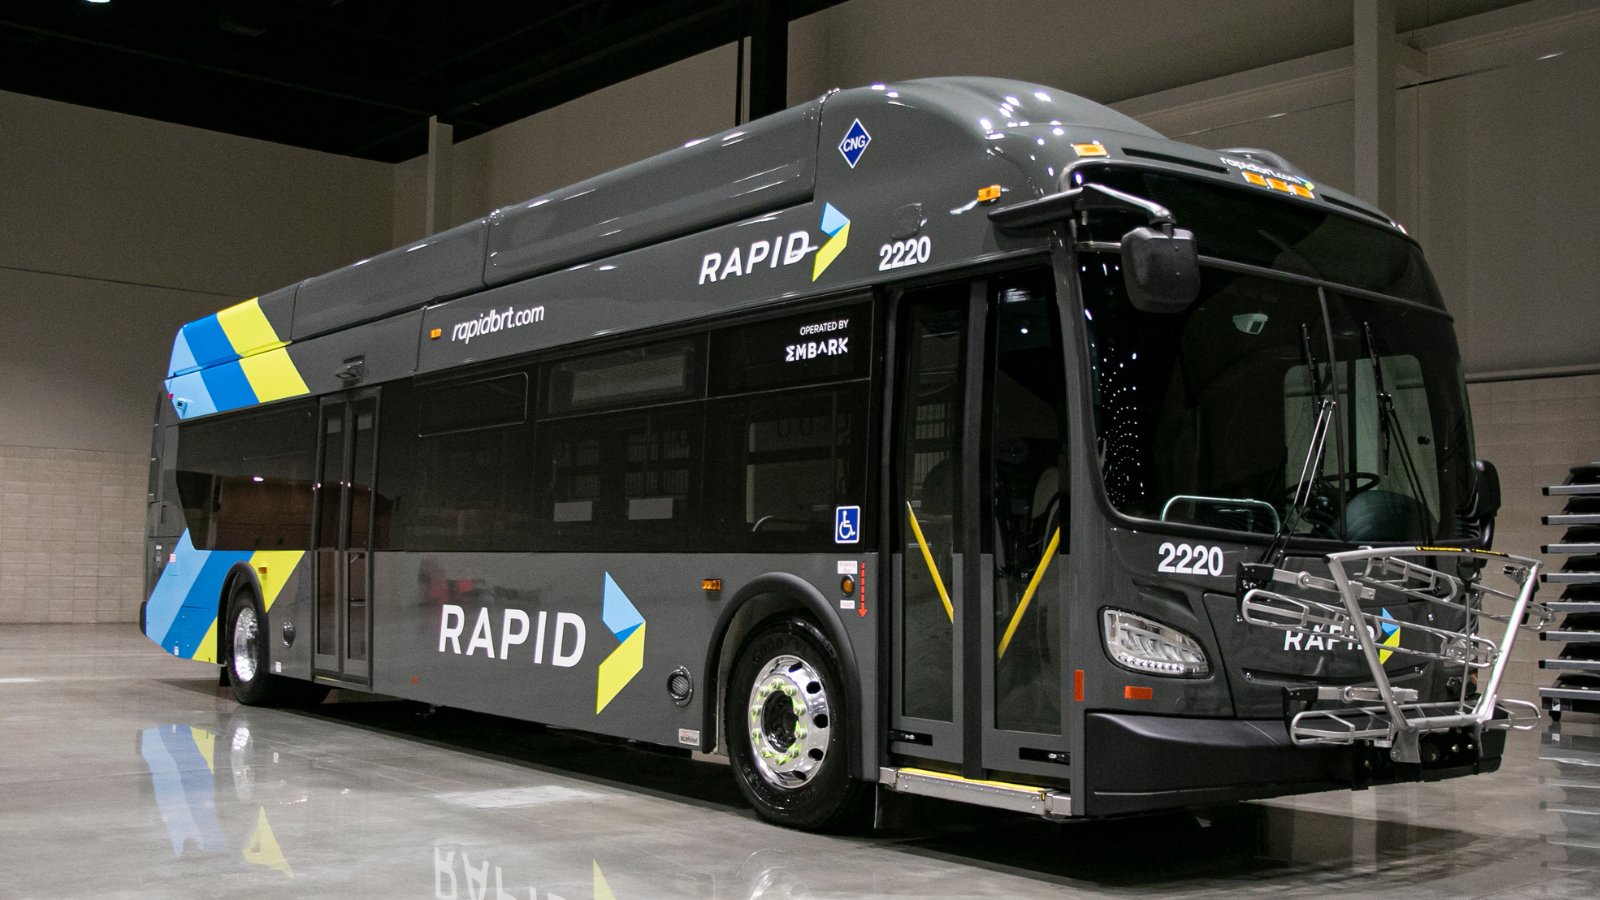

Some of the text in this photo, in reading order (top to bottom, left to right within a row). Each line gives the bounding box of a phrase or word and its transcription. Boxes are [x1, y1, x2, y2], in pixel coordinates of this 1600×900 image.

[843, 135, 866, 152] CNG
[698, 230, 810, 285] RAPID
[878, 235, 931, 272] 2220
[451, 305, 545, 345] rapidbrt.com
[800, 319, 849, 336] OPERATED BY
[785, 337, 849, 362] EMBARK
[1158, 542, 1224, 577] 2220
[438, 604, 587, 668] RAPID
